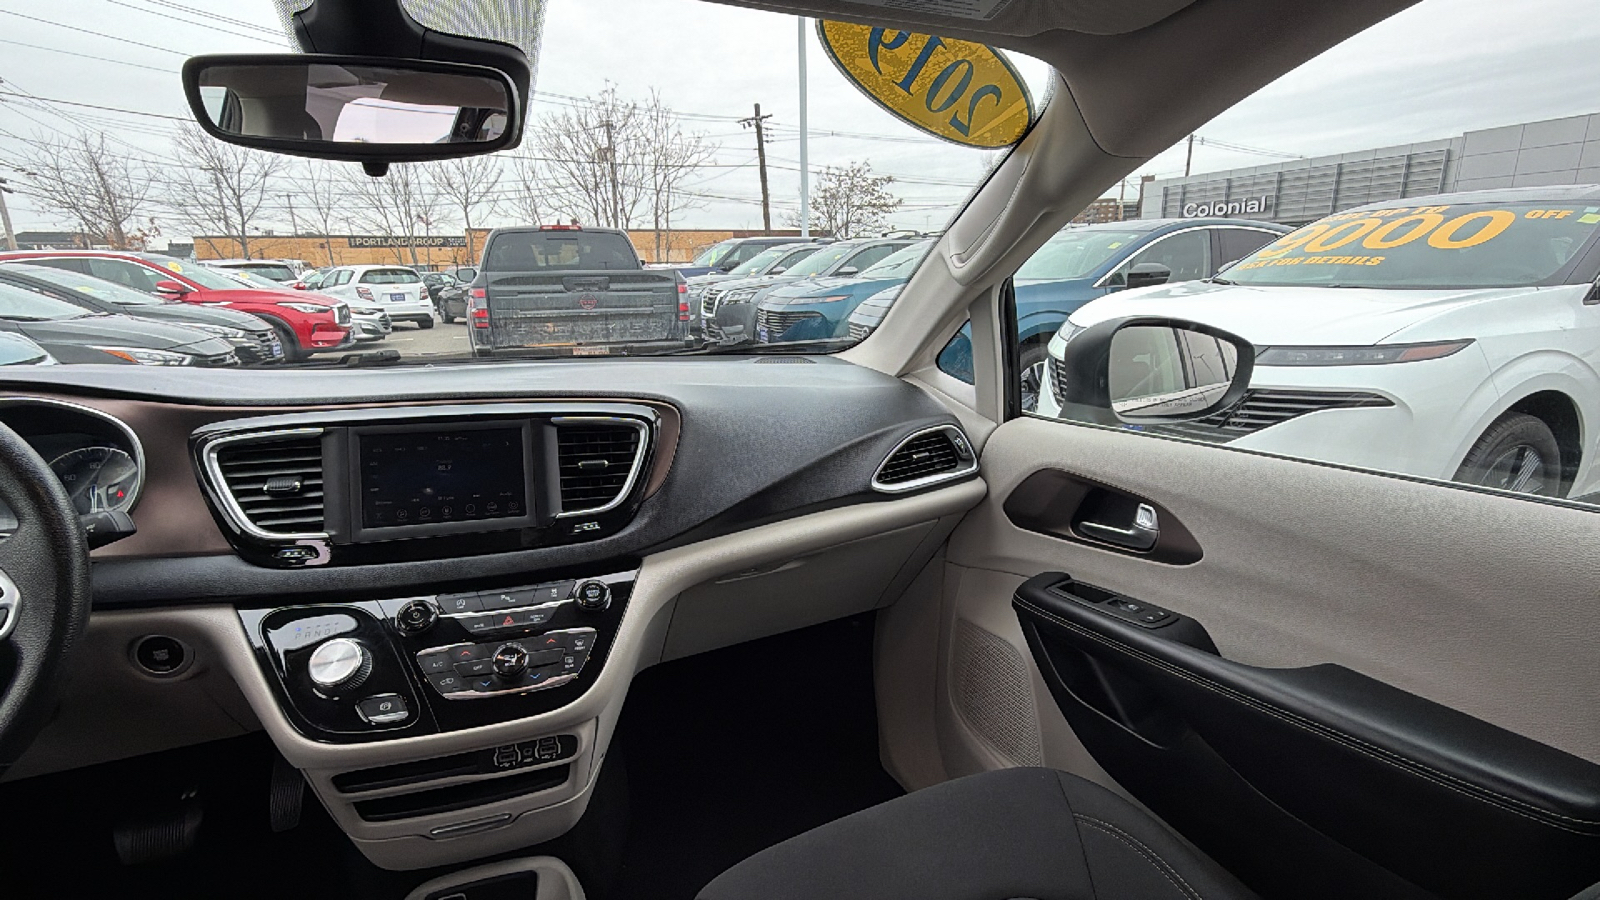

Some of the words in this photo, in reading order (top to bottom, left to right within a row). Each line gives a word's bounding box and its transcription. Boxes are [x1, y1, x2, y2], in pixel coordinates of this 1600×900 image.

[1183, 195, 1266, 218] Colonial
[1524, 209, 1574, 220] OFF
[1267, 256, 1305, 267] FOR
[1303, 256, 1386, 267] DETAILS
